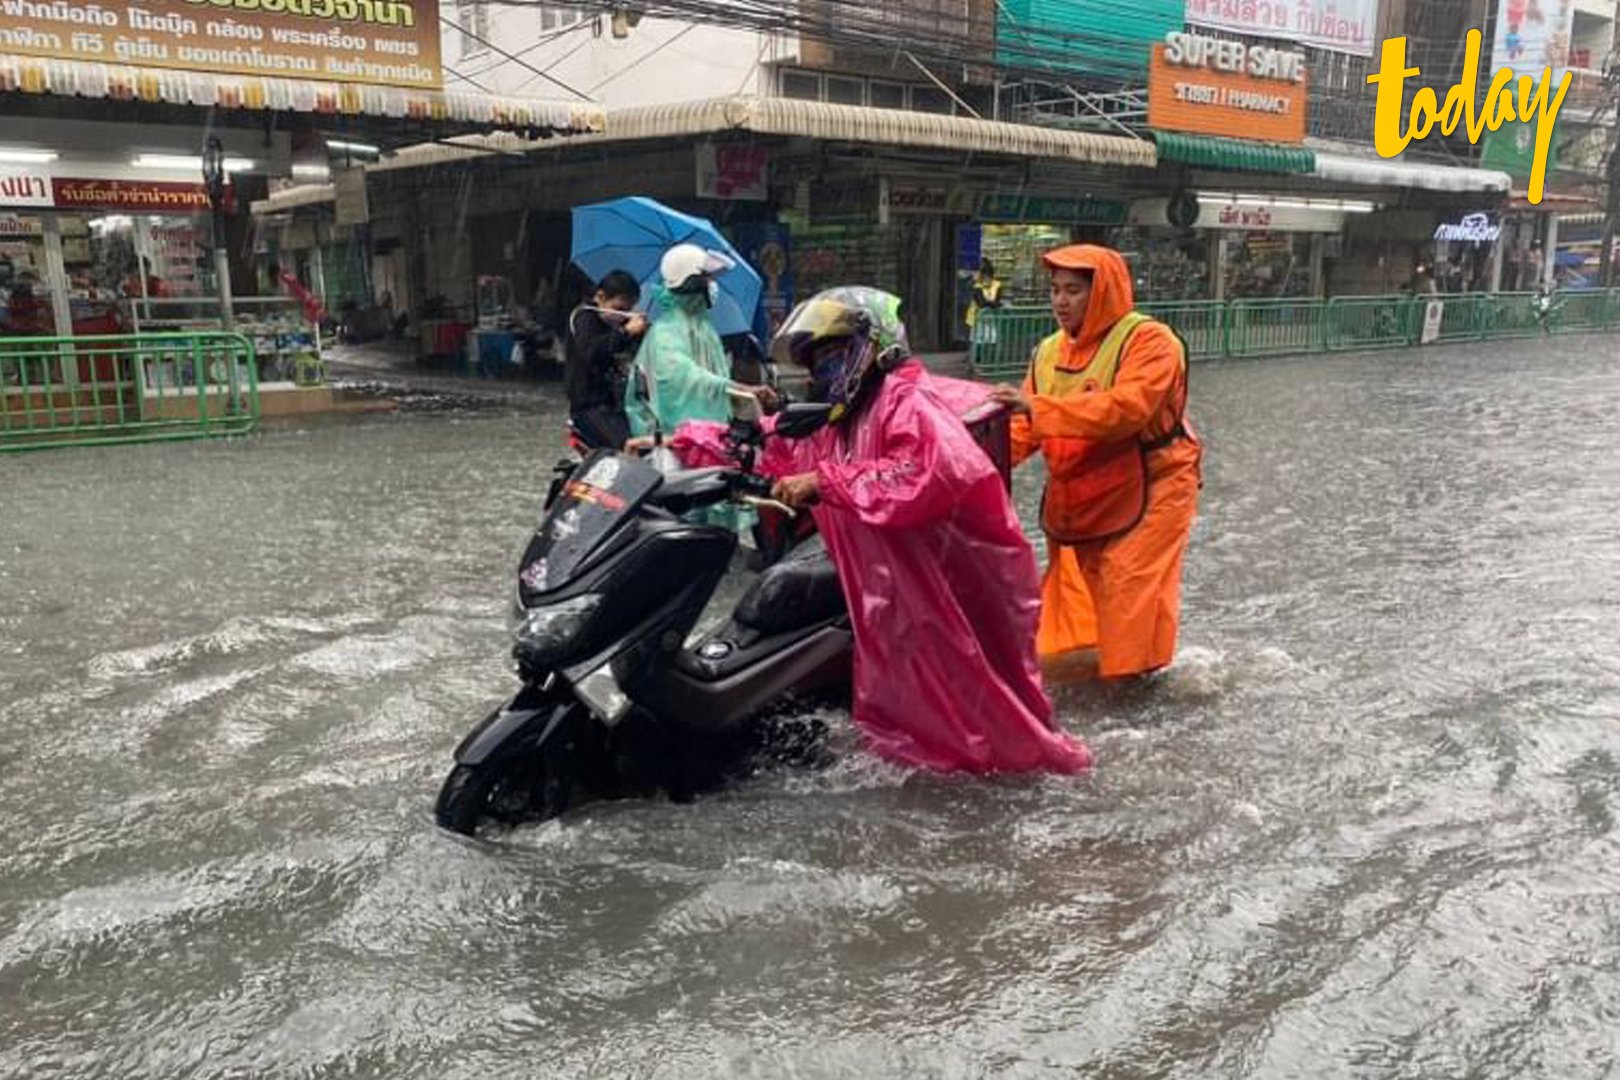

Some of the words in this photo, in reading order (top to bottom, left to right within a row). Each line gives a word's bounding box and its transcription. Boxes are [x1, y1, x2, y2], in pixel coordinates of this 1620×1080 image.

[72, 31, 104, 53] ทีวี
[114, 35, 168, 62] ตู้เย็น
[206, 17, 264, 42] กล้อง
[272, 26, 366, 50] พระเครื่อง
[1164, 30, 1246, 73] SUPER
[1248, 45, 1306, 83] SAVE
[1228, 88, 1292, 114] PHARMACY
